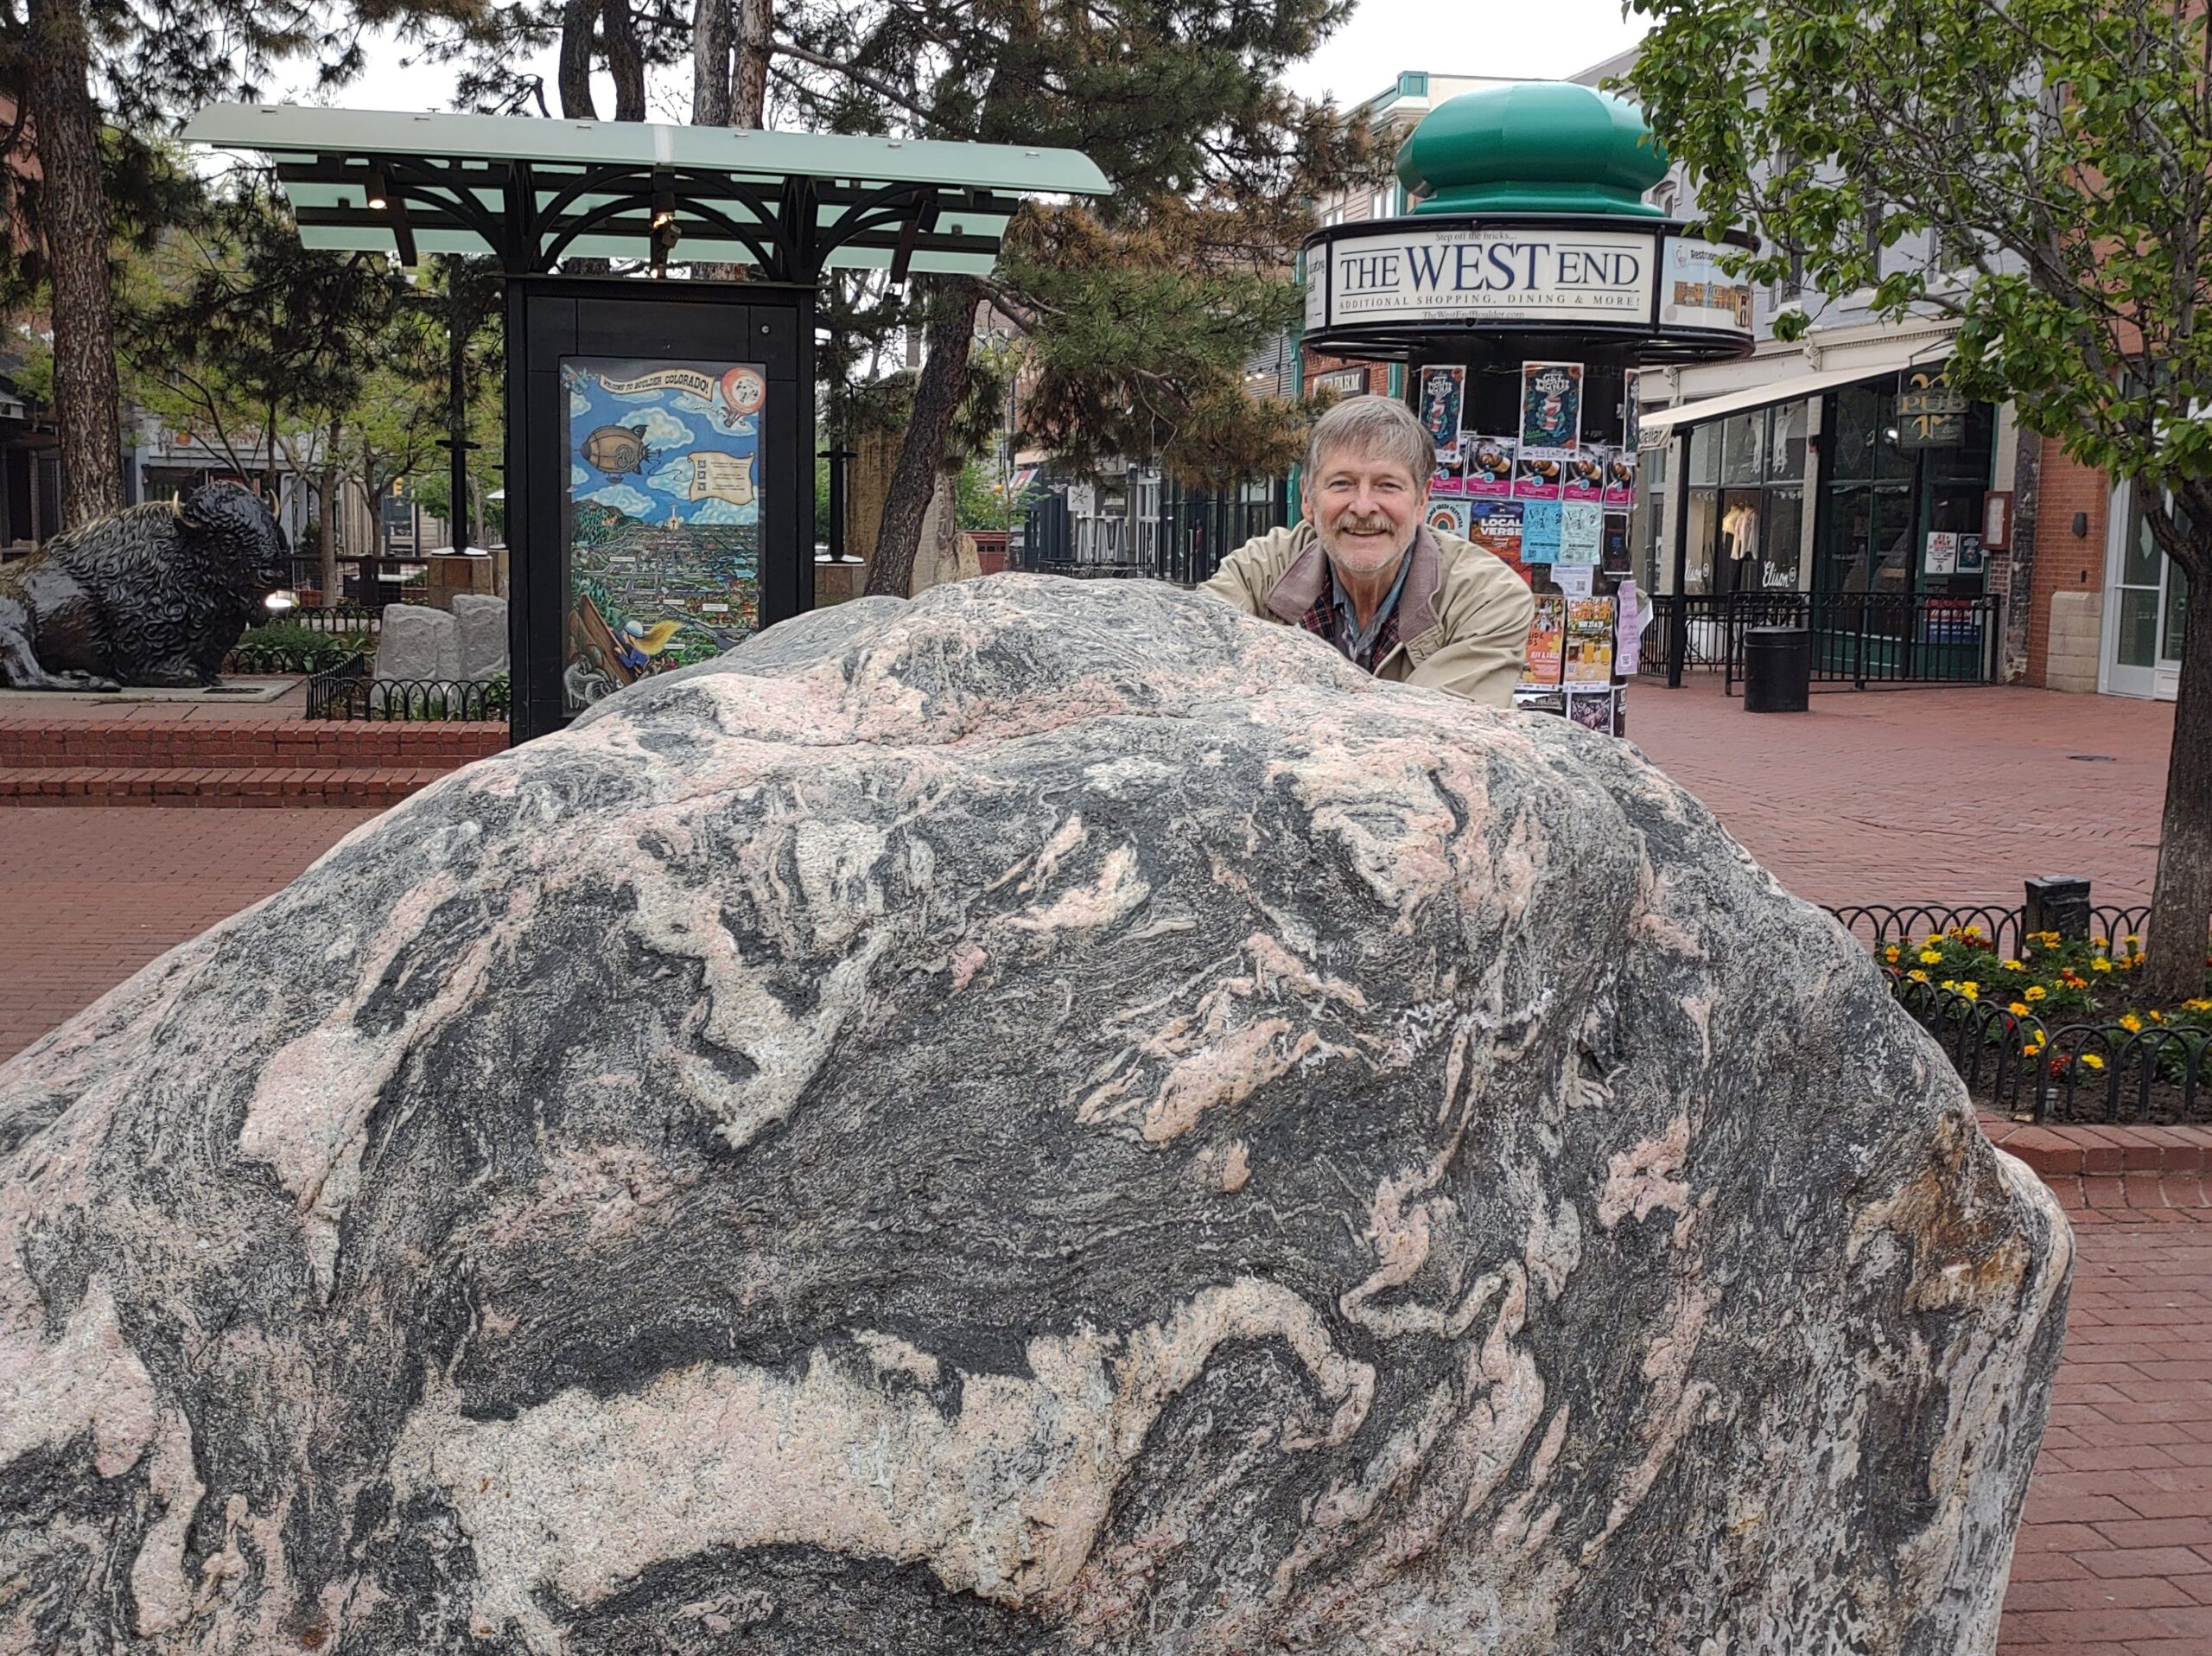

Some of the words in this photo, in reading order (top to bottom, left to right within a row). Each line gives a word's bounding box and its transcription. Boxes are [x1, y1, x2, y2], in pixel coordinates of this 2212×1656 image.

[1435, 232, 1451, 242] Step
[1468, 232, 1481, 240] the
[1340, 255, 1401, 290] THE
[1404, 243, 1550, 292] WEST
[1554, 252, 1640, 285] END
[1339, 296, 1410, 309] ADDITIONAL
[1507, 294, 1566, 304] DINING
[1593, 296, 1640, 307] MORE!
[664, 373, 709, 394] COLORADO!
[1902, 394, 1967, 412] PUB
[1481, 518, 1523, 527] LOCAL
[1480, 527, 1523, 536] VERSE
[1762, 560, 1789, 588] Elison
